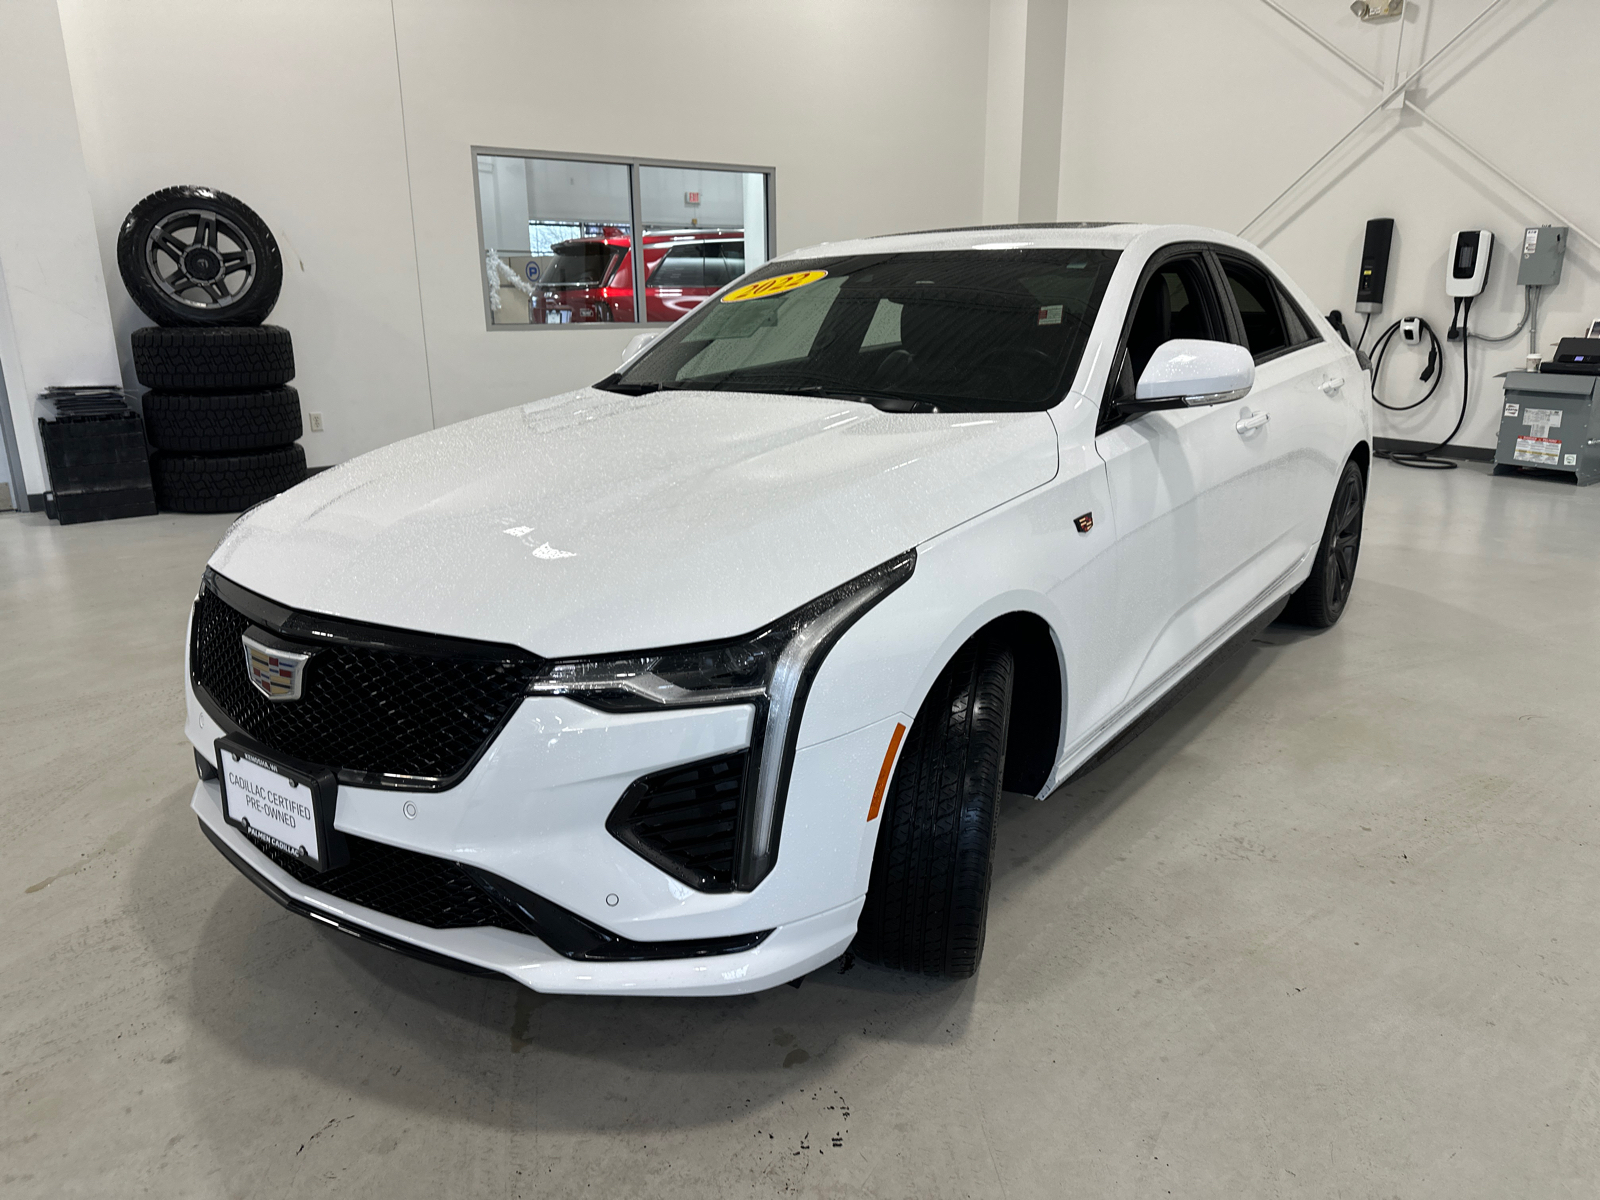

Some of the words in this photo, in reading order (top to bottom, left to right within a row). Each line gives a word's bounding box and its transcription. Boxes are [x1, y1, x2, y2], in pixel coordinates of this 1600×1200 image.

[734, 273, 811, 299] 2022
[229, 772, 266, 801] CADILLAC
[268, 790, 311, 820] CERTIFIED
[246, 794, 296, 828] PRE-OWNED
[247, 826, 271, 843] PALMEN
[271, 838, 299, 858] CADILLAC
